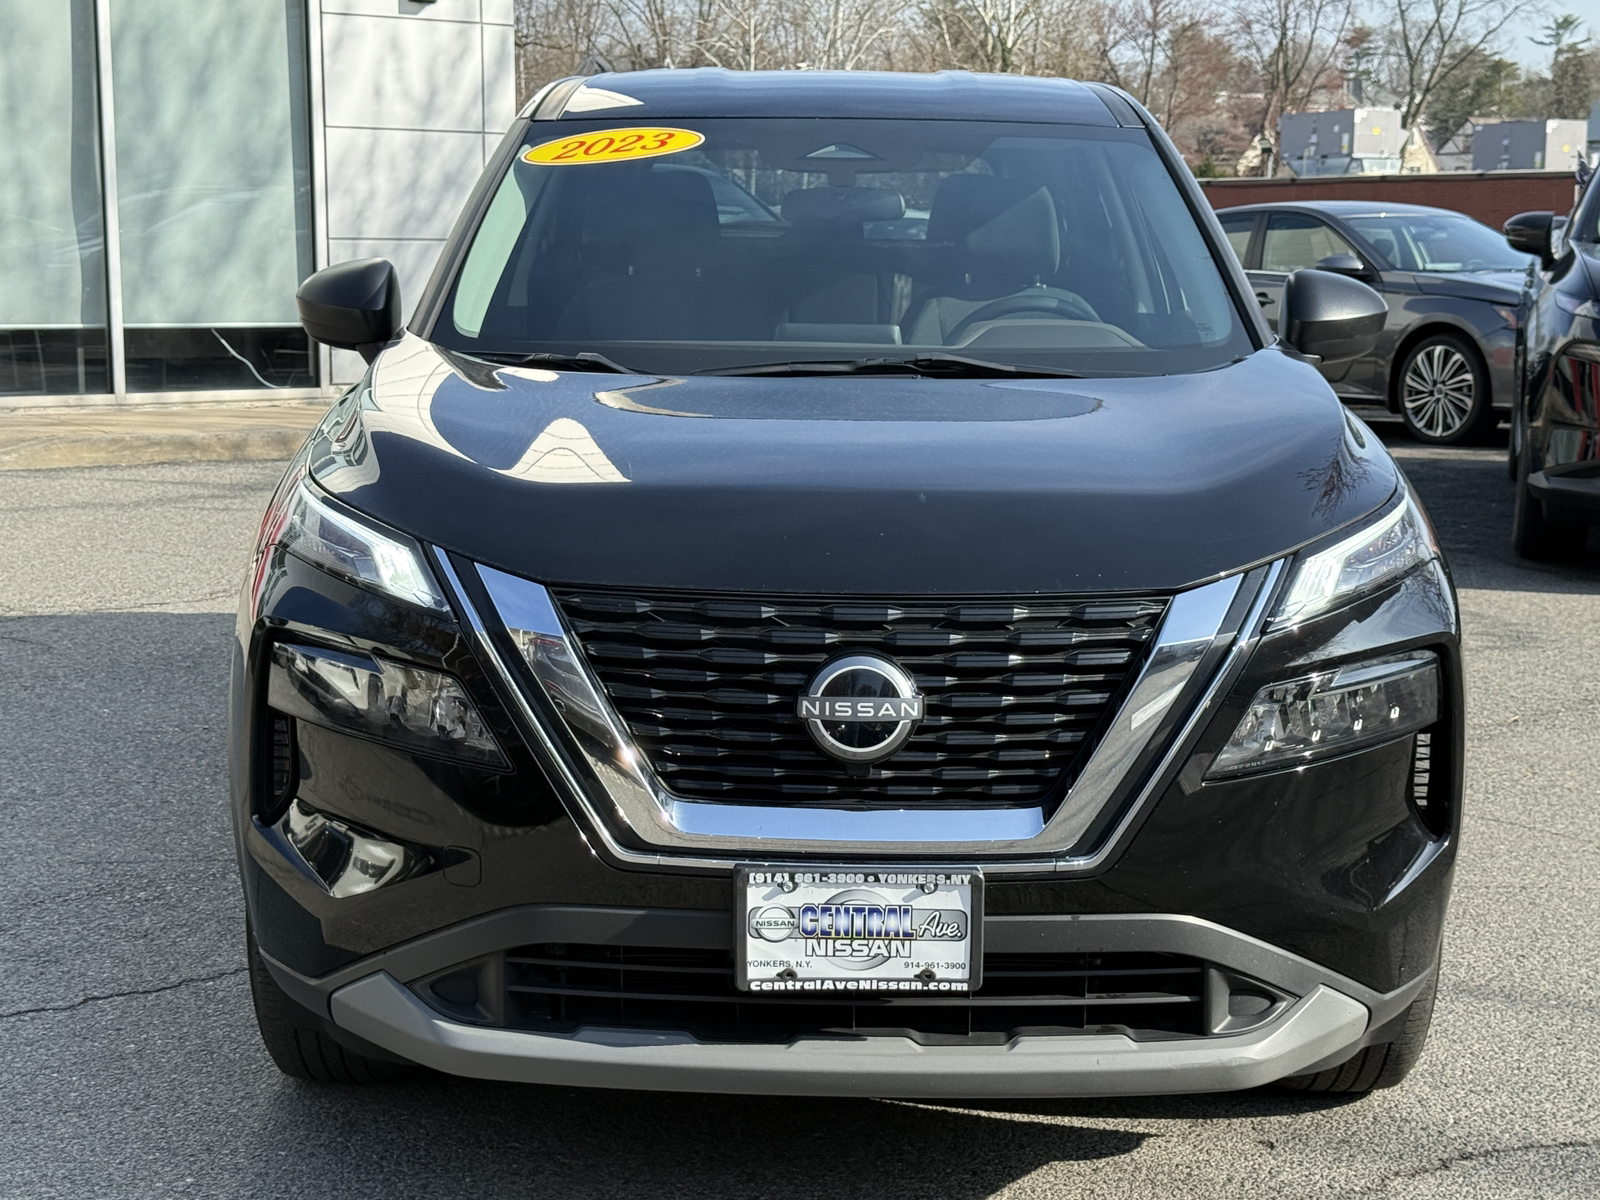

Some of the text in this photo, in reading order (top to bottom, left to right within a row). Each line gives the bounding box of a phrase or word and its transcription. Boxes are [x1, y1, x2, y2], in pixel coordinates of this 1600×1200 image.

[551, 132, 675, 160] 2023
[802, 700, 919, 717] NISSAN
[794, 873, 865, 884] 961-3900
[799, 903, 963, 939] CENTRAL Ave.
[805, 938, 911, 958] NISSAN
[747, 960, 812, 968] YONKERS, N.Y.
[904, 961, 967, 970] 914-961-3900
[750, 980, 969, 991] CentralAveNissan.com
